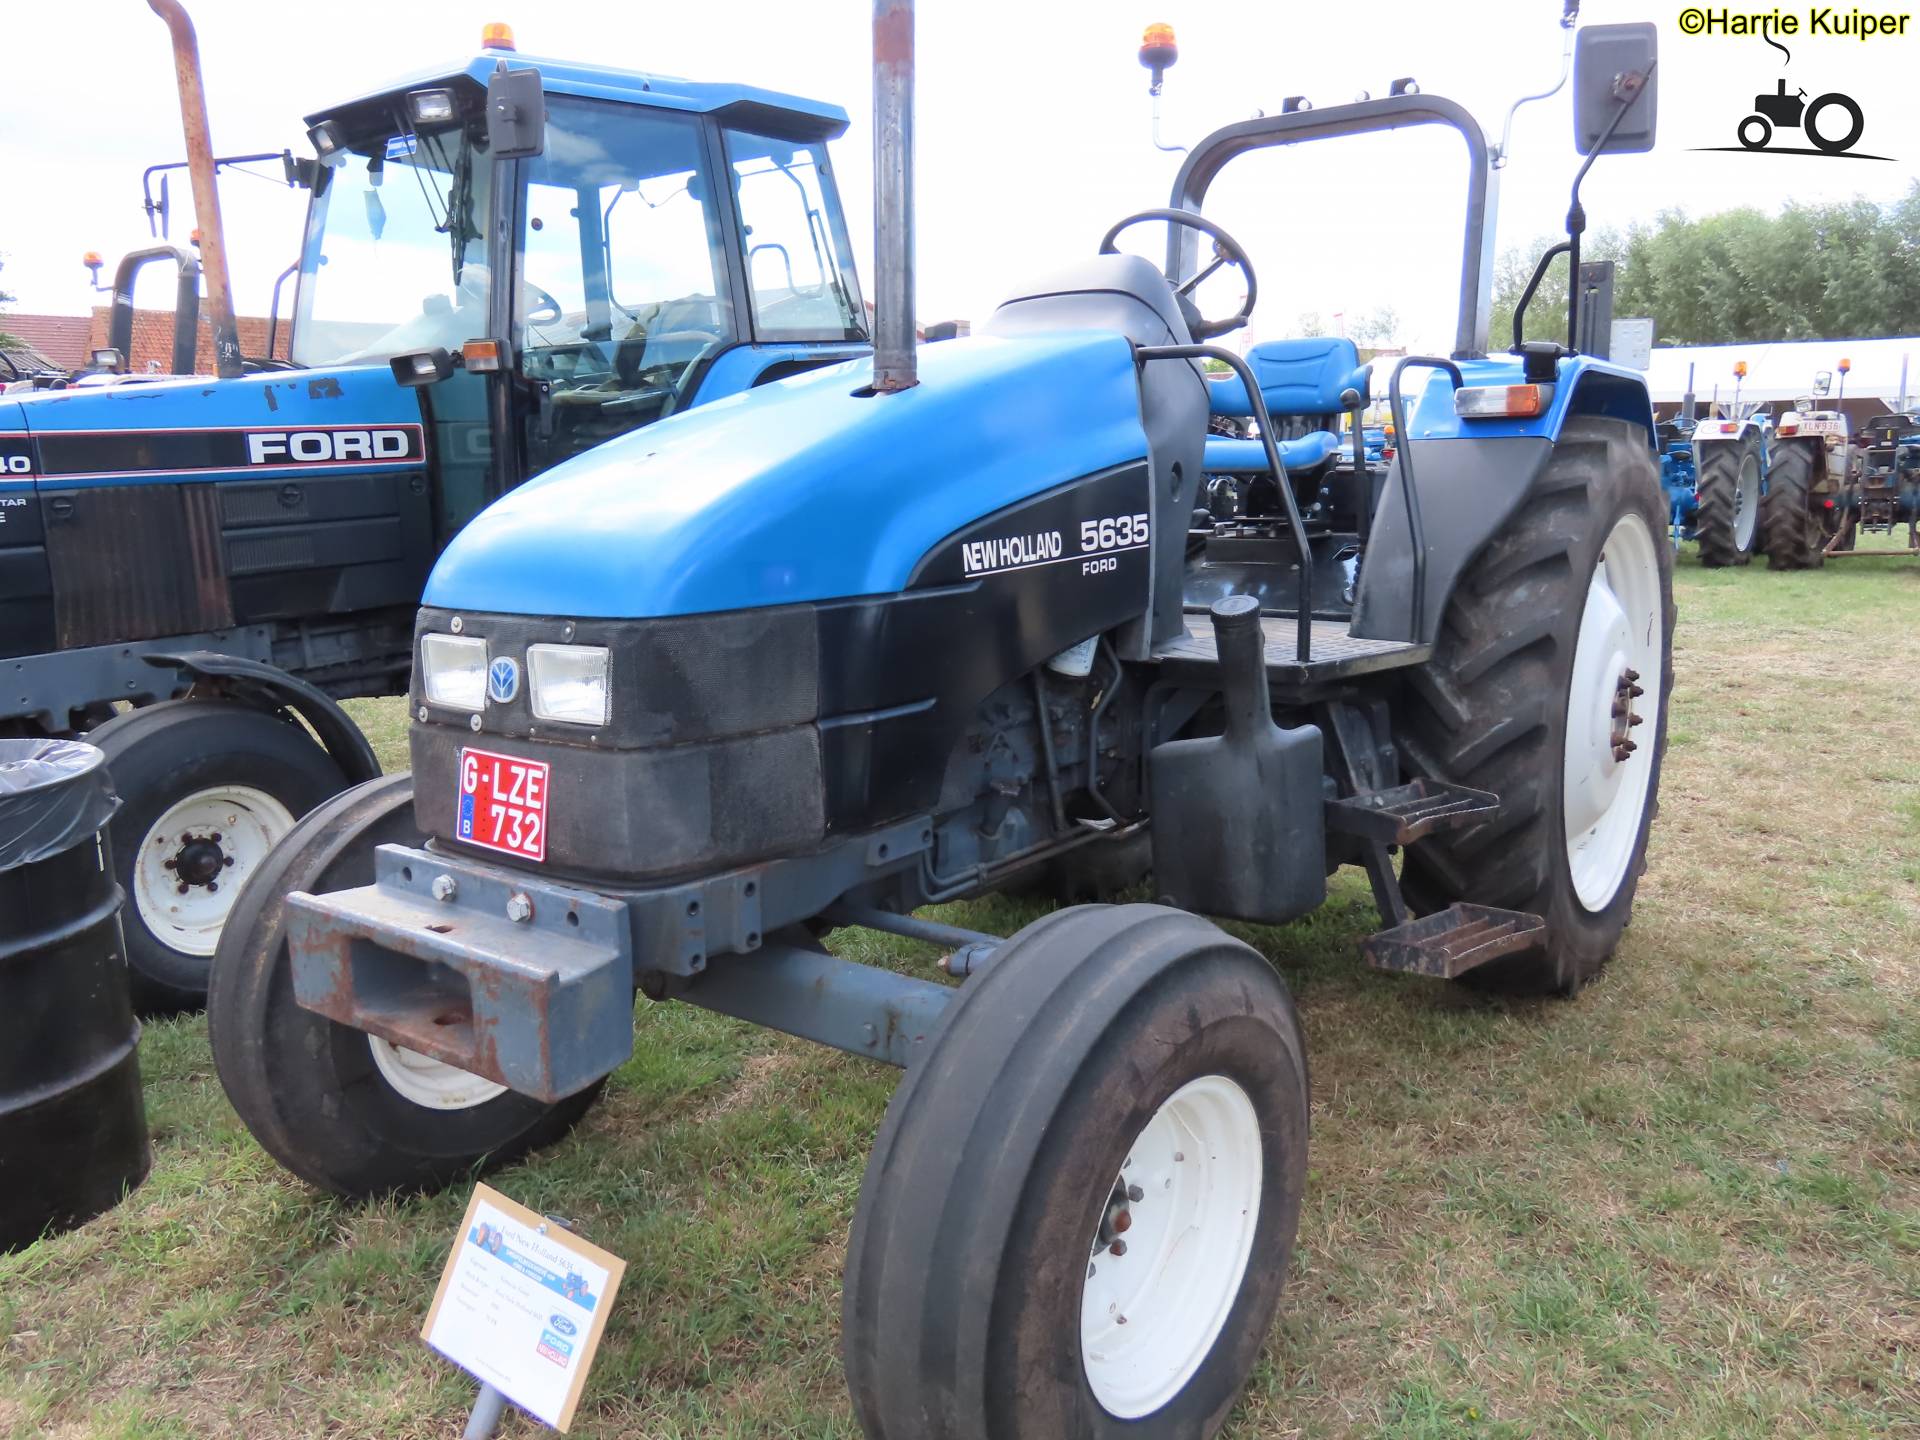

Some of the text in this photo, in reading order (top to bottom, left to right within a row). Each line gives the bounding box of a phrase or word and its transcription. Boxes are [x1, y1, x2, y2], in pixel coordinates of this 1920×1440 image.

[248, 430, 409, 464] FORD
[962, 514, 1149, 572] NEW HOLLAND 5635
[1082, 557, 1117, 576] FORD
[463, 819, 471, 834] B
[491, 804, 541, 852] 732
